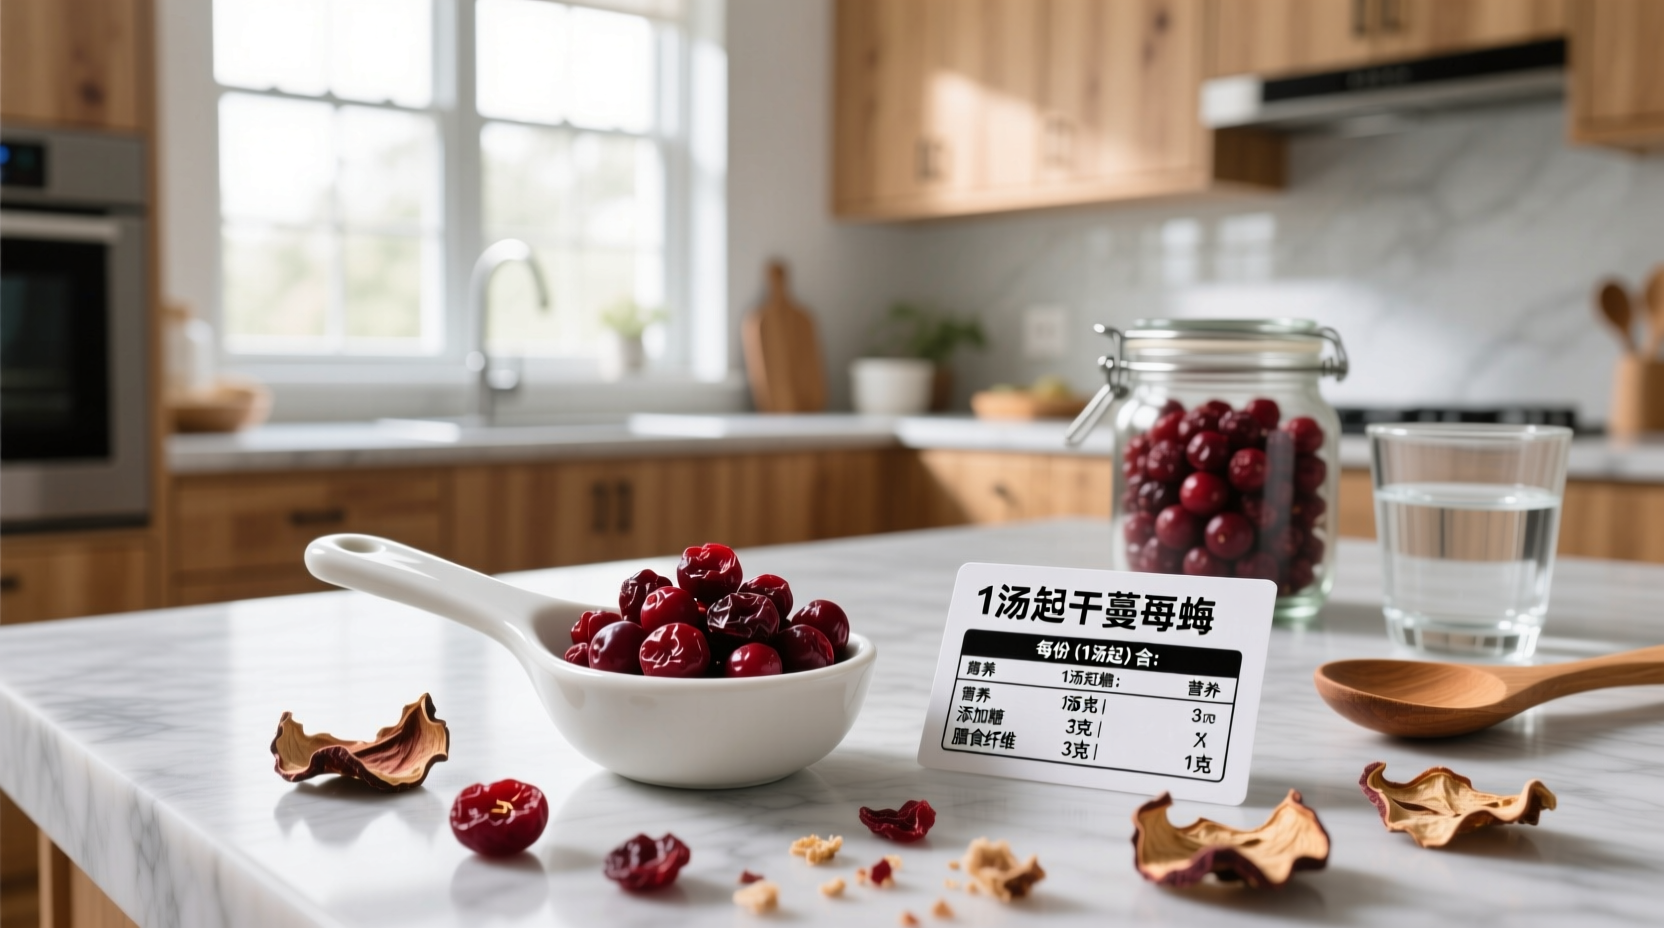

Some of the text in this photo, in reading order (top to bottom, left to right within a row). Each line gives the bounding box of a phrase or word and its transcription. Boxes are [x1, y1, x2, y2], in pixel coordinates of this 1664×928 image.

[1035, 639, 1070, 660] 每份
[1065, 718, 1093, 737] 3克
[1061, 739, 1090, 760] 3克
[1184, 754, 1213, 774] 1克
